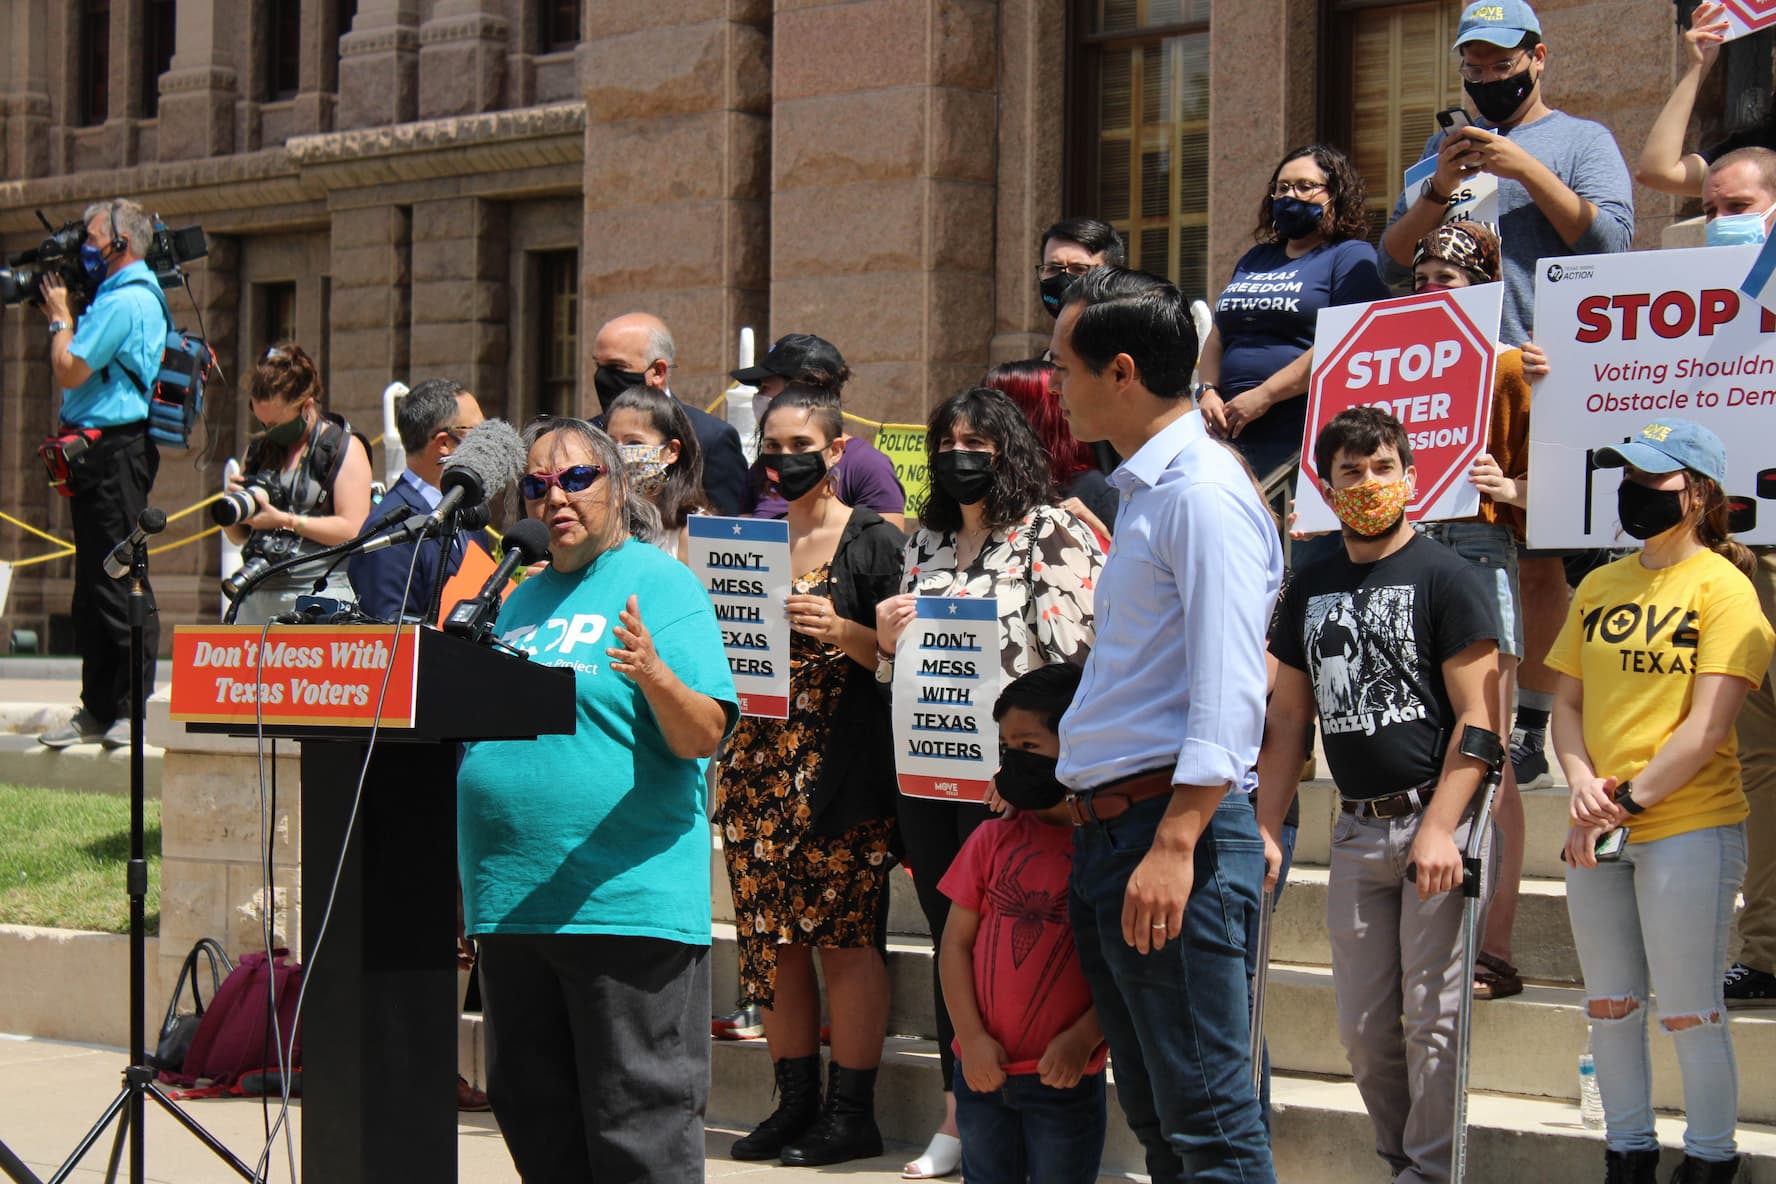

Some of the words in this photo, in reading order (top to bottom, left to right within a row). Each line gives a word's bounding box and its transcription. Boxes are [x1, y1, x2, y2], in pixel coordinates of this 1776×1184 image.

[1448, 188, 1473, 207] SS
[1245, 269, 1299, 281] TEXAS
[1562, 271, 1594, 280] ACTION
[1222, 281, 1304, 295] FREEDOM
[1575, 288, 1740, 344] STOP
[1345, 340, 1462, 389] STOP
[1593, 361, 1668, 384] Voting
[1586, 389, 1689, 413] Obstacle
[1696, 390, 1719, 408] to
[879, 434, 924, 452] POLICE
[709, 552, 763, 569] DON'T
[711, 577, 764, 595] MESS
[715, 604, 760, 621] WITH
[721, 631, 768, 648] EXAS
[923, 632, 976, 649] DON'T
[193, 640, 259, 668] Don't
[261, 641, 323, 669] Mess
[330, 639, 389, 669] With
[727, 657, 773, 675] TERS
[922, 659, 976, 676] MESS
[215, 677, 284, 705] Texas
[290, 678, 369, 706] Voters
[922, 686, 970, 704] WITH
[913, 713, 976, 731] TEXAS
[1381, 704, 1426, 727] star
[908, 740, 982, 759] VOTERS
